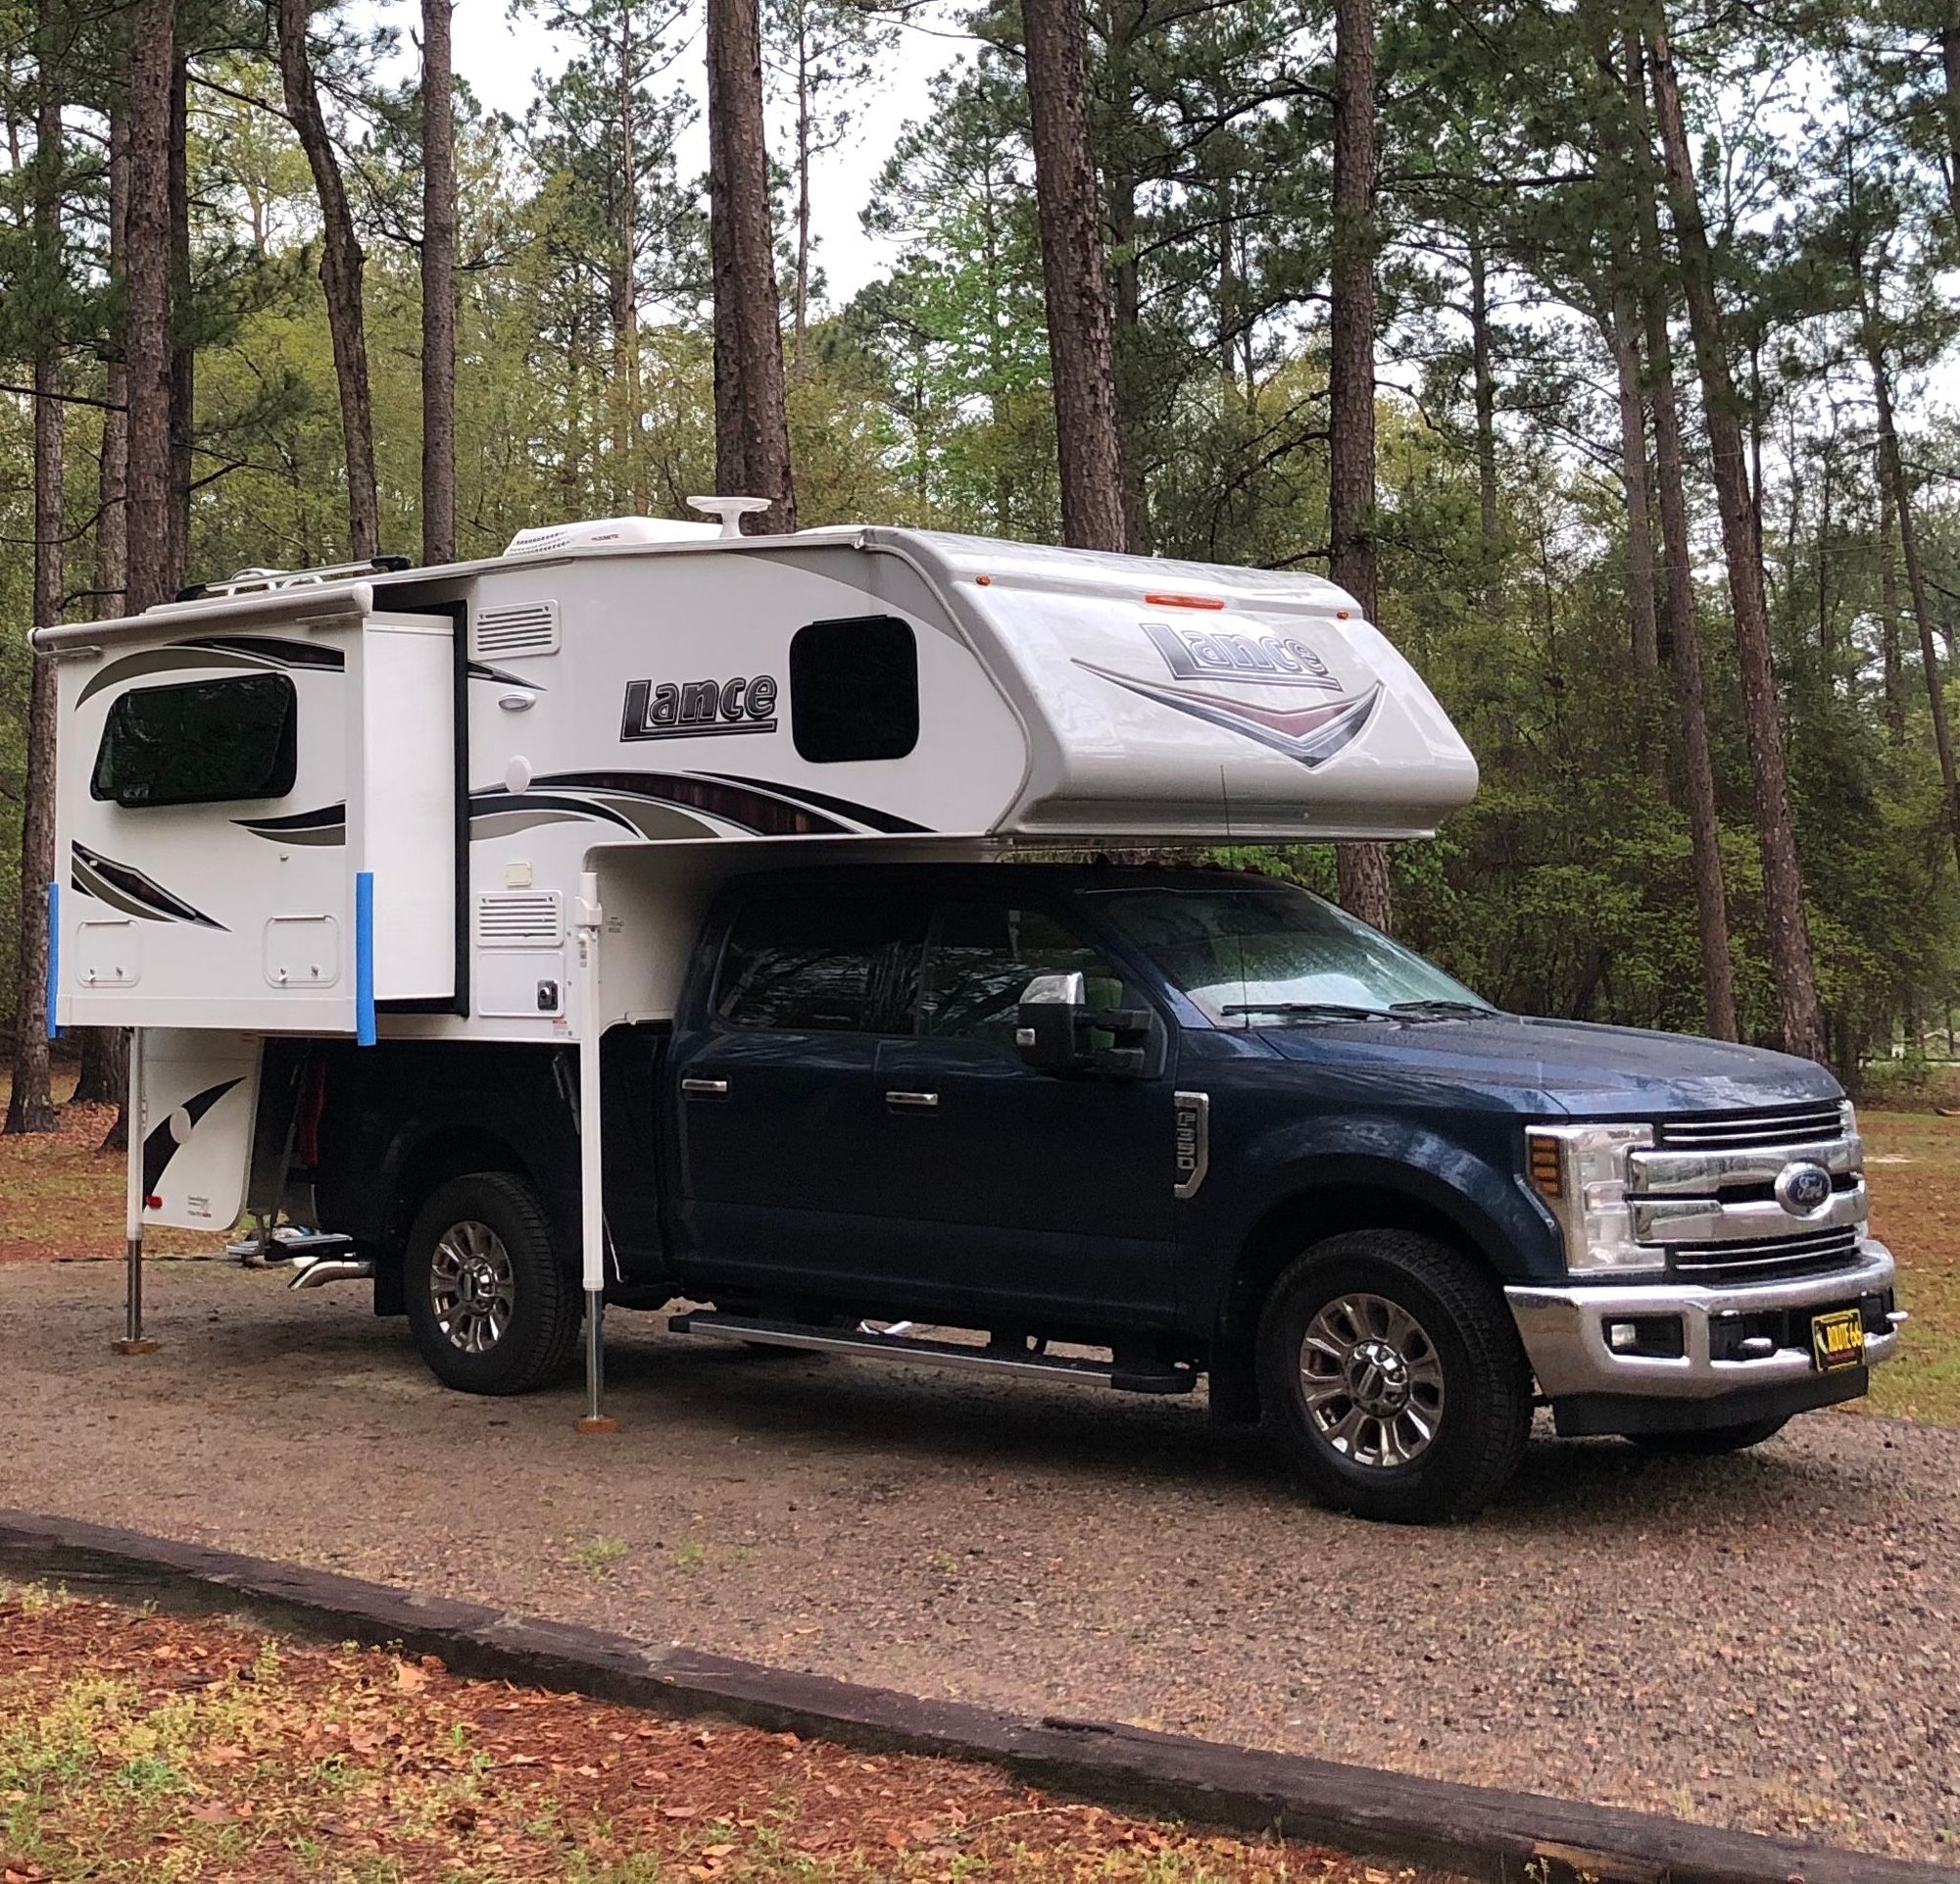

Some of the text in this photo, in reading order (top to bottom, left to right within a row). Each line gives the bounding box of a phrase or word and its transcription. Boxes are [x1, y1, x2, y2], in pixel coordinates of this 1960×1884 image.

[1139, 622, 1344, 692] Lance
[619, 674, 778, 743] Lance
[1796, 1175, 1824, 1201] Ford
